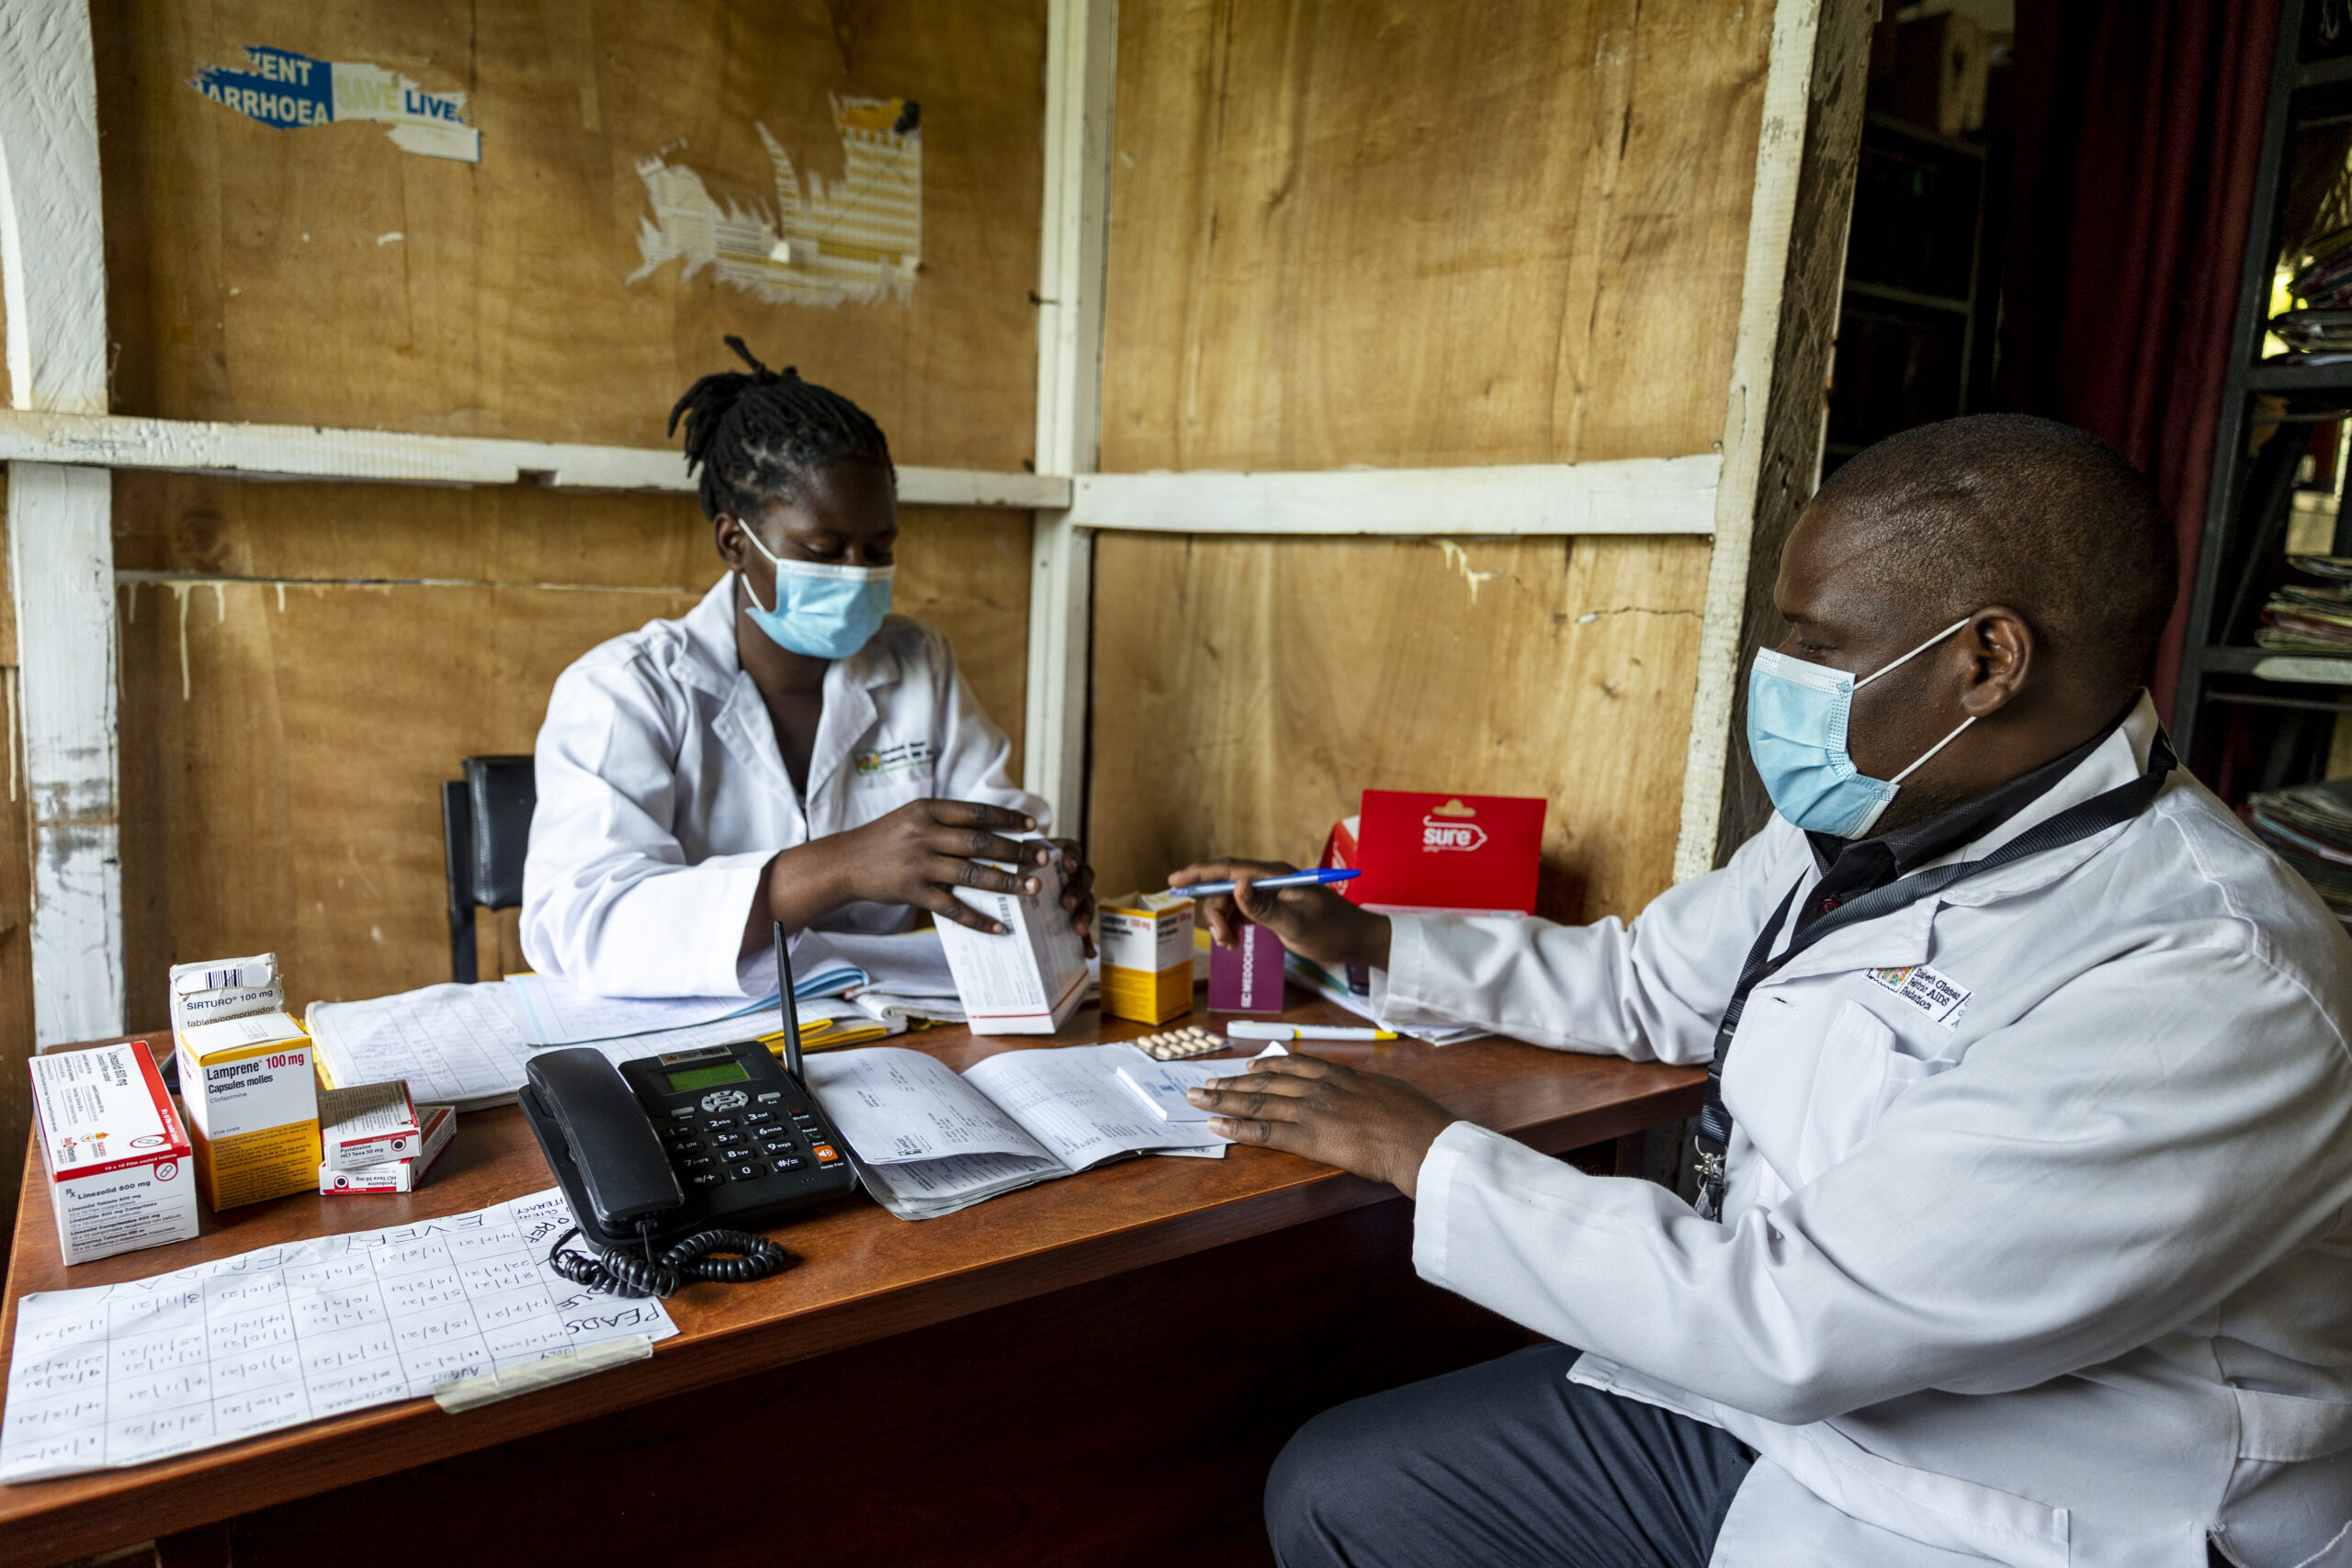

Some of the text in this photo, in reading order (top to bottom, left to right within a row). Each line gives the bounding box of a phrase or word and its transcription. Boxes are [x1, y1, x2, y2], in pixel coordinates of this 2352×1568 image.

[335, 73, 465, 124] SAVE LIVE
[1423, 828, 1471, 847] sure
[240, 992, 257, 1002] 100
[259, 989, 274, 998] mg
[1926, 988, 1950, 1007] AIDS
[1935, 979, 1962, 1000] Glaser
[266, 1055, 286, 1069] 100
[288, 1054, 304, 1066] mg
[209, 1091, 247, 1104] Clofazimine
[340, 1145, 371, 1153] Pyridoxine
[77, 1187, 117, 1200] Linezolid
[119, 1183, 135, 1191] 600
[138, 1180, 152, 1189] mg
[517, 1197, 563, 1214] ITERACY
[566, 1302, 660, 1336] PEADS
[540, 1348, 571, 1360] JULY
